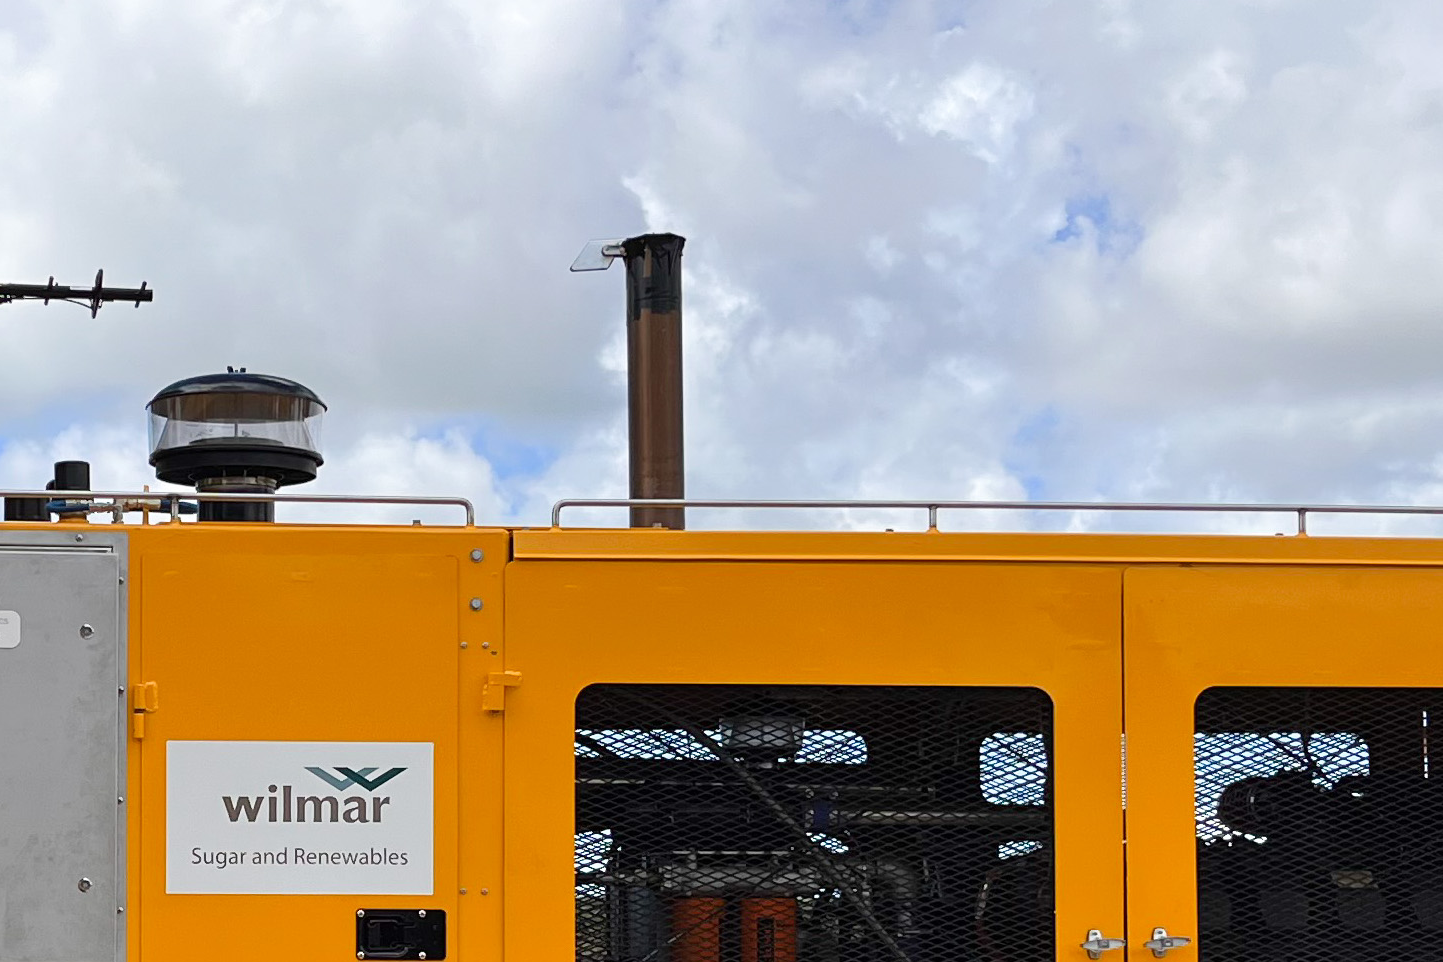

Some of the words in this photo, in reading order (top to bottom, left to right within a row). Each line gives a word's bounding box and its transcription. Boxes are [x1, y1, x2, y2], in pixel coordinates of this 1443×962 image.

[221, 784, 391, 824] wilmar
[191, 847, 247, 869] Sugar
[251, 846, 288, 865] and
[294, 847, 409, 866] Renewables
